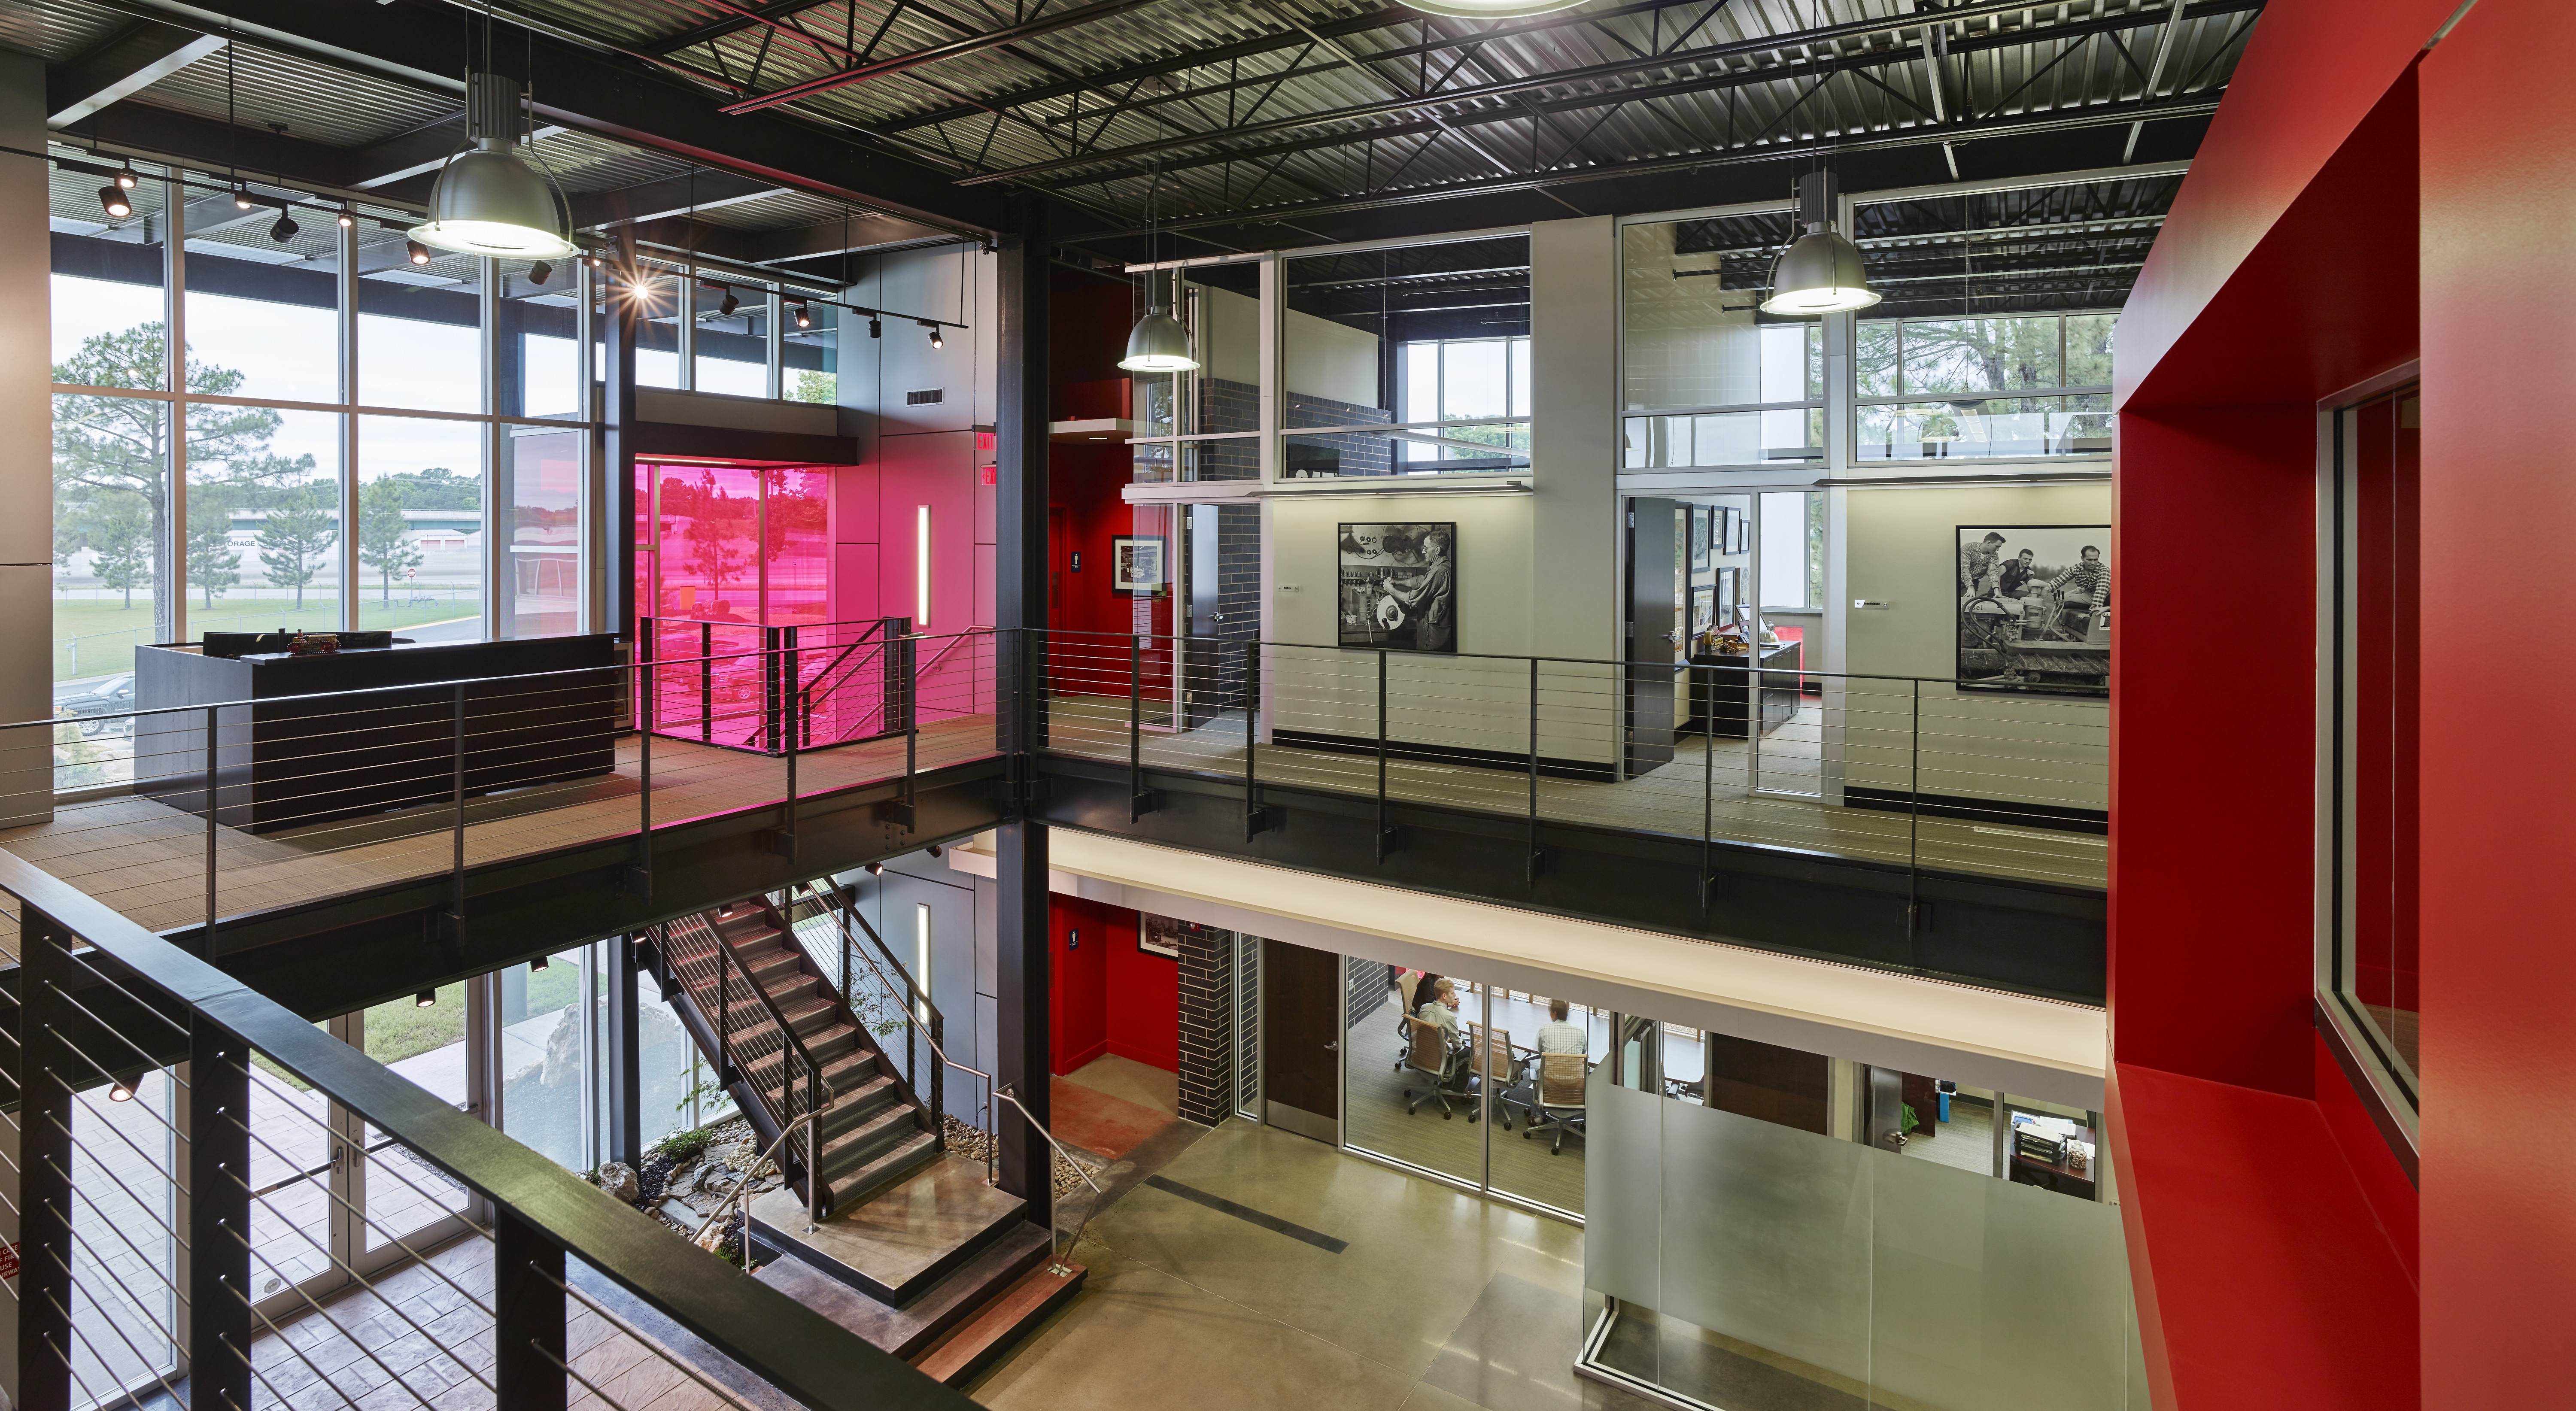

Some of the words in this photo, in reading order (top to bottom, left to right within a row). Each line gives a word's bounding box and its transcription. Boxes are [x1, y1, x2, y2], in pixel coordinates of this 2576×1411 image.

[978, 433, 993, 450] EXIT
[985, 468, 996, 484] EXI
[5, 1252, 18, 1262] FIR
[0, 1262, 12, 1271] USE
